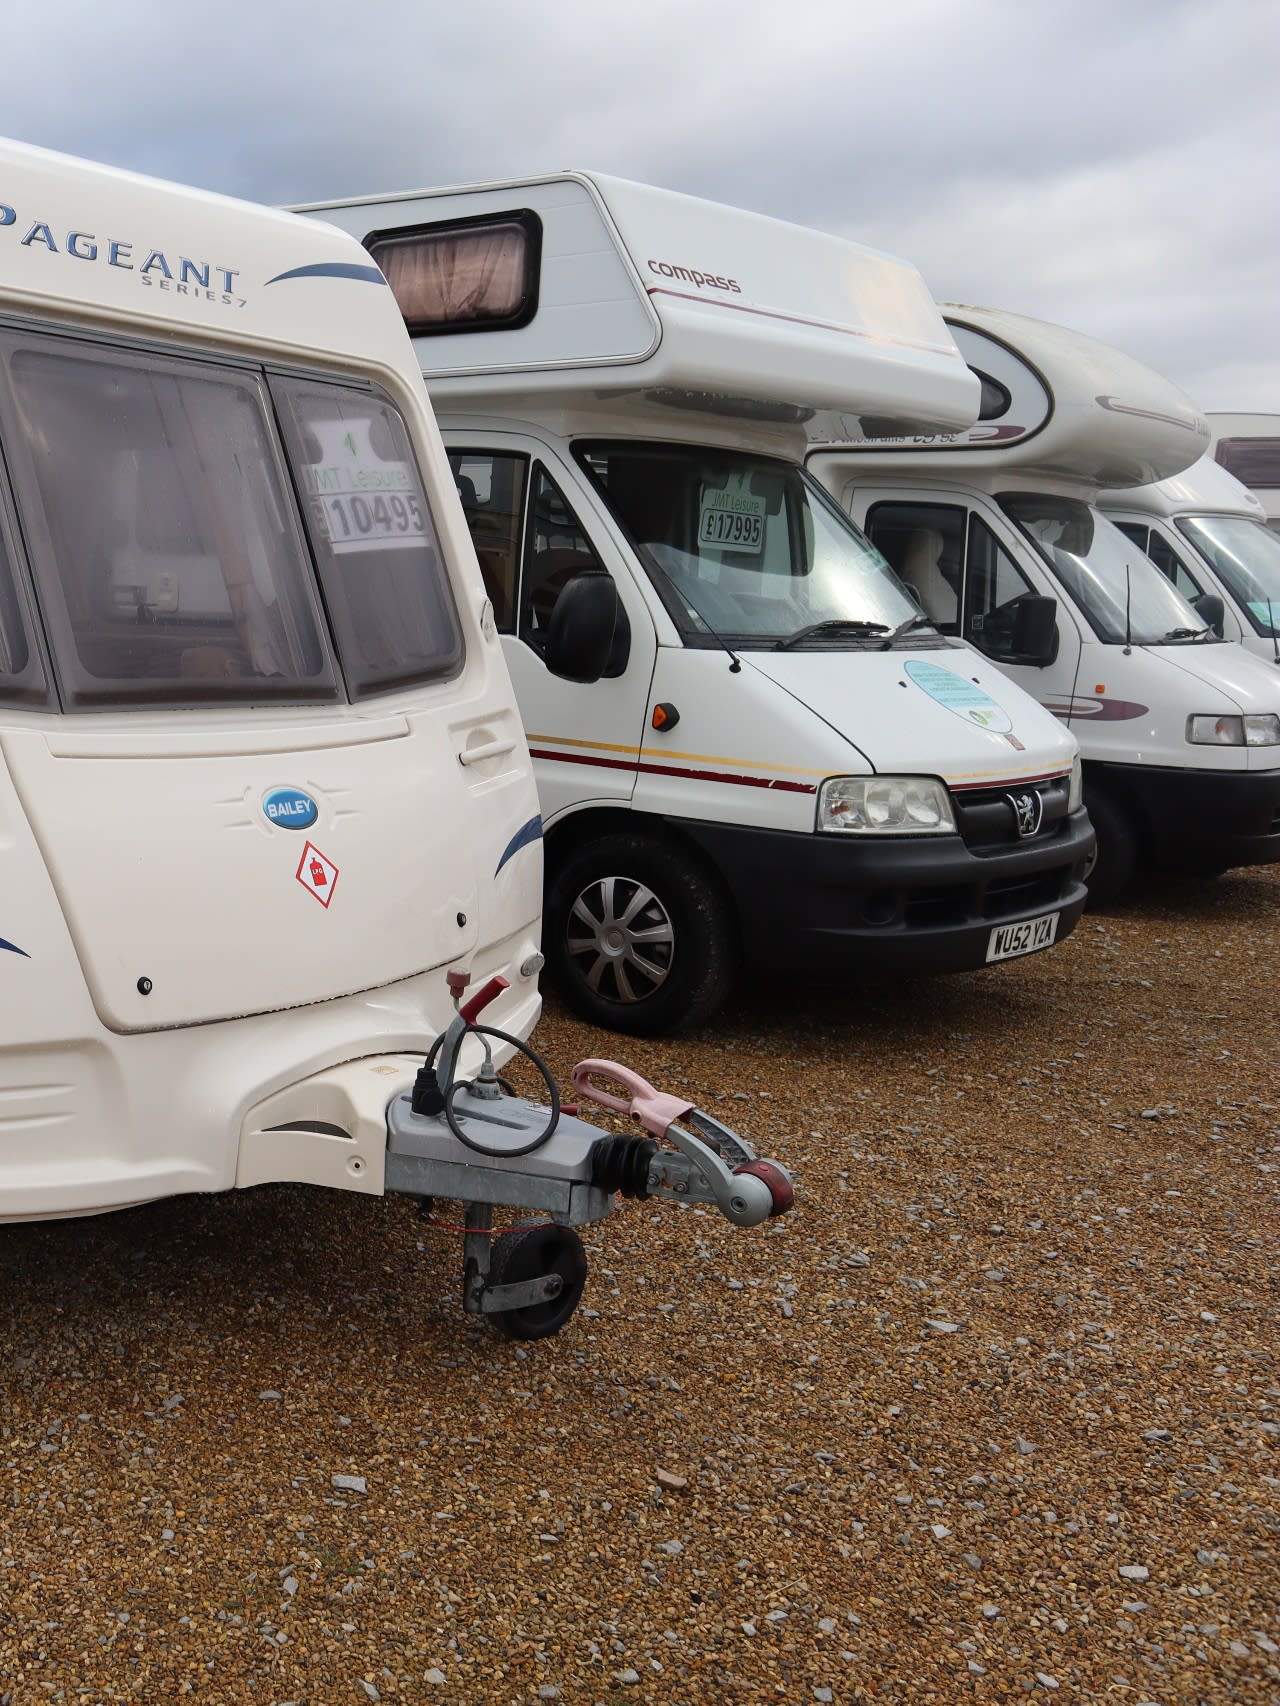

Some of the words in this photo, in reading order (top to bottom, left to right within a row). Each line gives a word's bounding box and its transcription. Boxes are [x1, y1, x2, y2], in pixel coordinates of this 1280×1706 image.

[647, 259, 742, 293] compass
[712, 491, 730, 508] JMT
[731, 493, 760, 513] Leisure
[706, 513, 761, 543] £17995
[267, 799, 312, 818] BAILEY
[994, 924, 1032, 955] WU52
[1032, 917, 1054, 947] YZA
